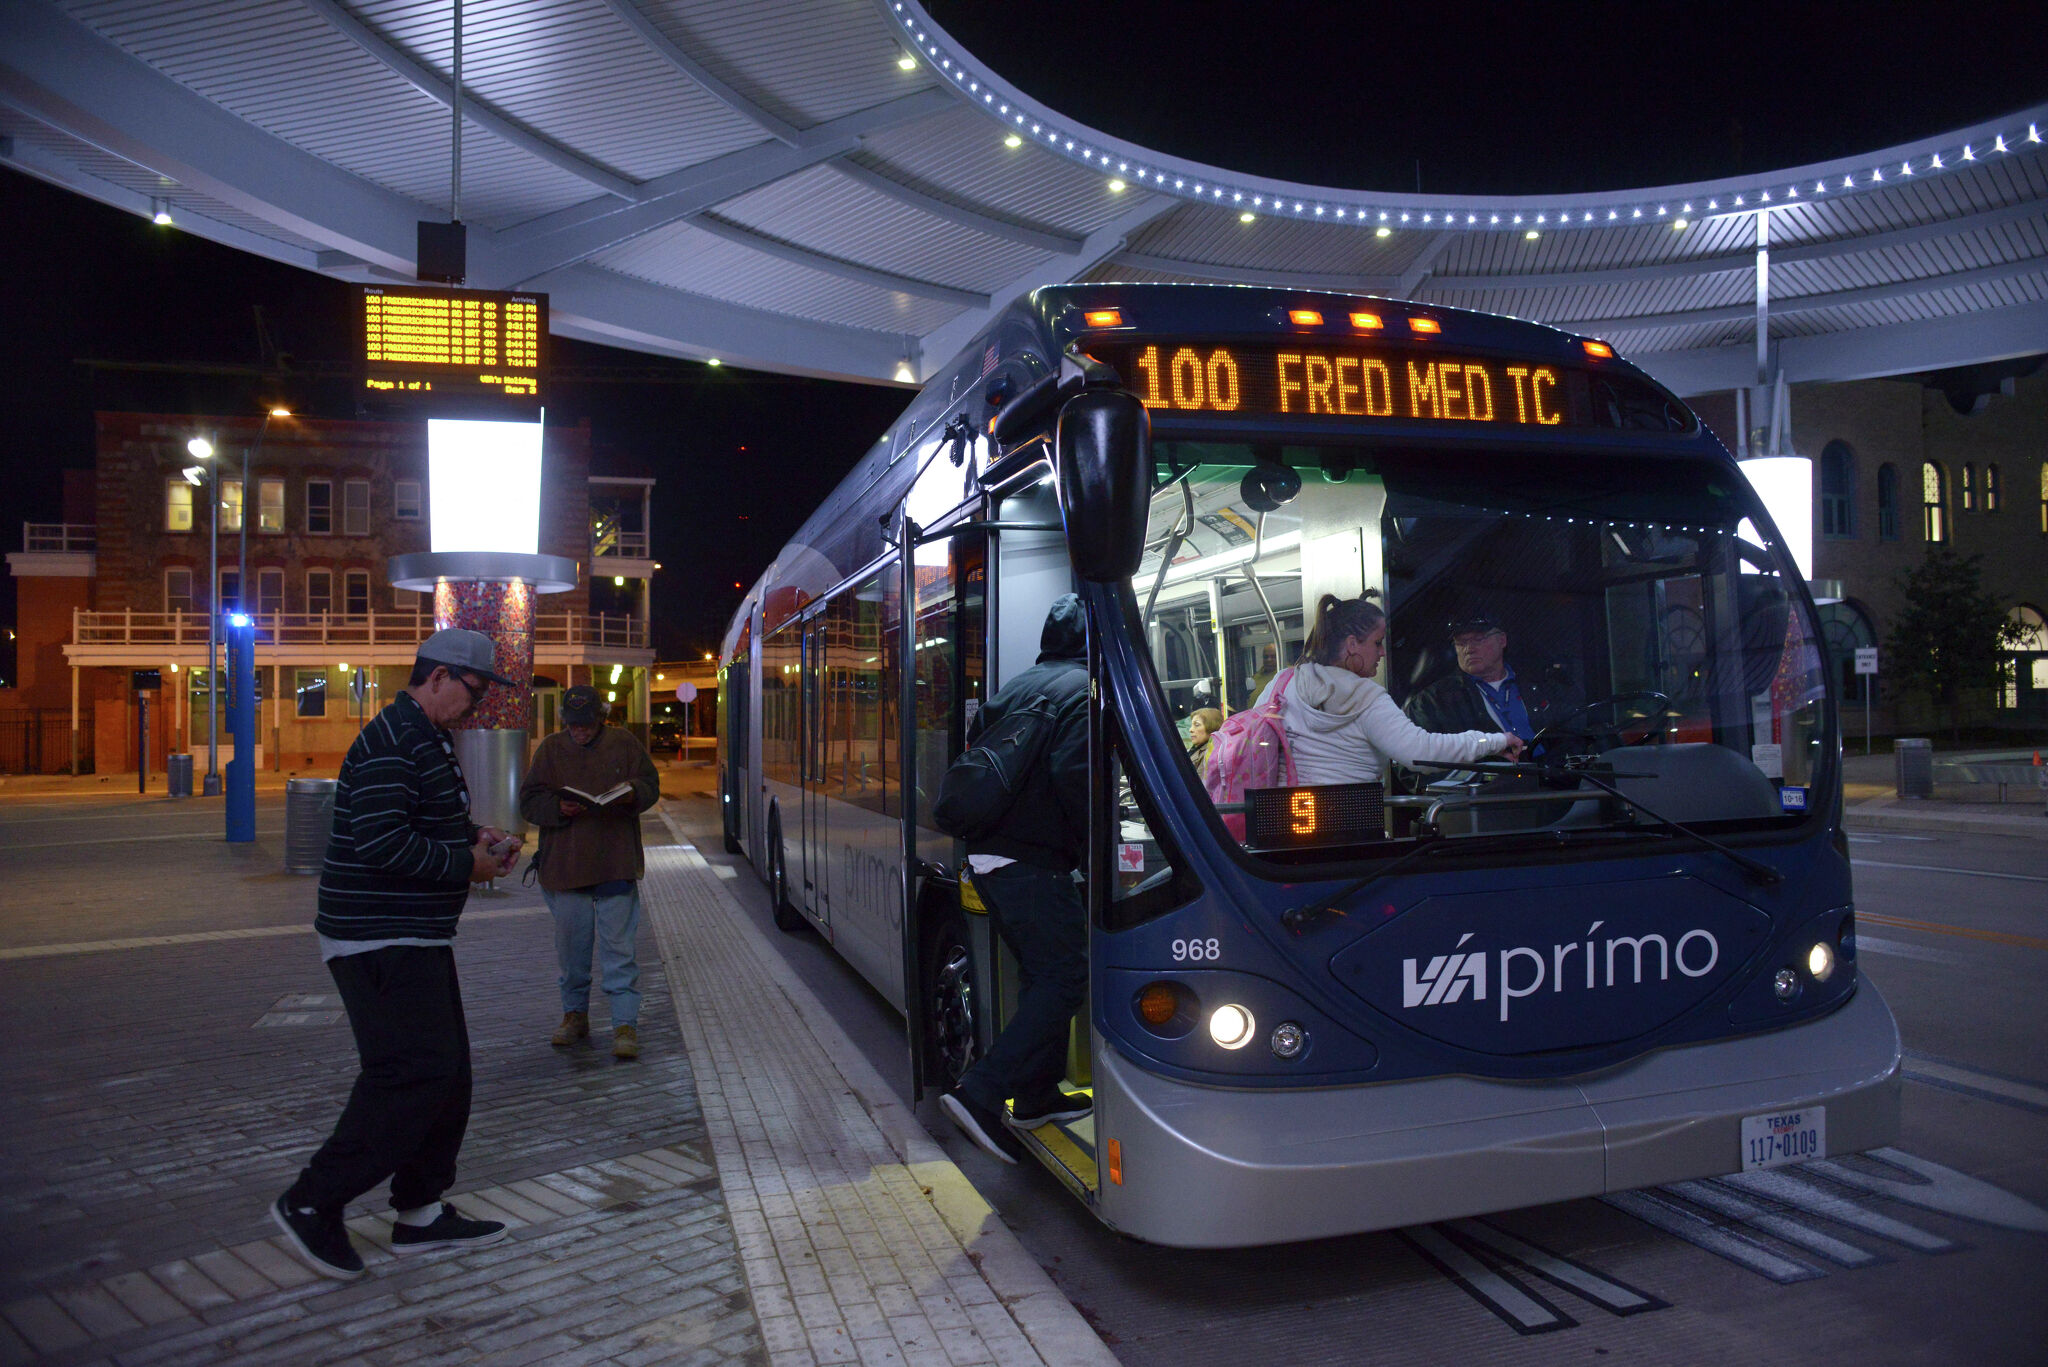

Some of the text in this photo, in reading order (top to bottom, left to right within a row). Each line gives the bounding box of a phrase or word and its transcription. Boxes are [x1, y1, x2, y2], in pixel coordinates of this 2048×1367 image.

[366, 296, 380, 304] 100
[382, 296, 449, 308] FREDERICKSBURG
[451, 300, 462, 308] RD
[464, 301, 480, 310] BRT
[526, 304, 536, 312] PM
[512, 296, 536, 305] Arriving
[366, 305, 380, 313] 100
[382, 305, 449, 318] FREDERICKSBURG
[450, 309, 464, 318] RD
[464, 310, 480, 320] BRT
[525, 313, 536, 322] PM
[366, 314, 381, 322] 100
[382, 315, 449, 327] FREDERICKSBURG
[451, 318, 462, 327] RD
[464, 319, 480, 328] BRT
[526, 322, 536, 331] PM
[366, 324, 381, 332] 100
[382, 324, 449, 336] FREDERICKSBURG
[451, 328, 464, 336] RD
[464, 328, 480, 338] BRT
[525, 332, 536, 340] PM
[367, 333, 381, 342] 100
[382, 334, 449, 345] FREDERICKSBURG
[450, 337, 464, 346] RD
[464, 338, 480, 346] BRT
[525, 341, 536, 349] PM
[367, 342, 382, 351] 100
[382, 343, 450, 354] FREDERICKSBURG
[451, 346, 463, 356] RD
[464, 347, 480, 356] BRT
[525, 350, 536, 358] PM
[367, 352, 382, 360] 100
[382, 352, 450, 363] FREDERICKSBURG
[451, 355, 463, 364] RD
[464, 356, 480, 364] BRT
[525, 359, 536, 367] PM
[367, 379, 431, 390] Page 1 of 1
[504, 386, 525, 394] Dec
[1138, 346, 1560, 425] 100 FRED MED TC
[230, 648, 239, 709] Emergency
[1292, 792, 1315, 833] 9
[1172, 938, 1220, 961] 968
[1768, 1114, 1801, 1128] TEXAS
